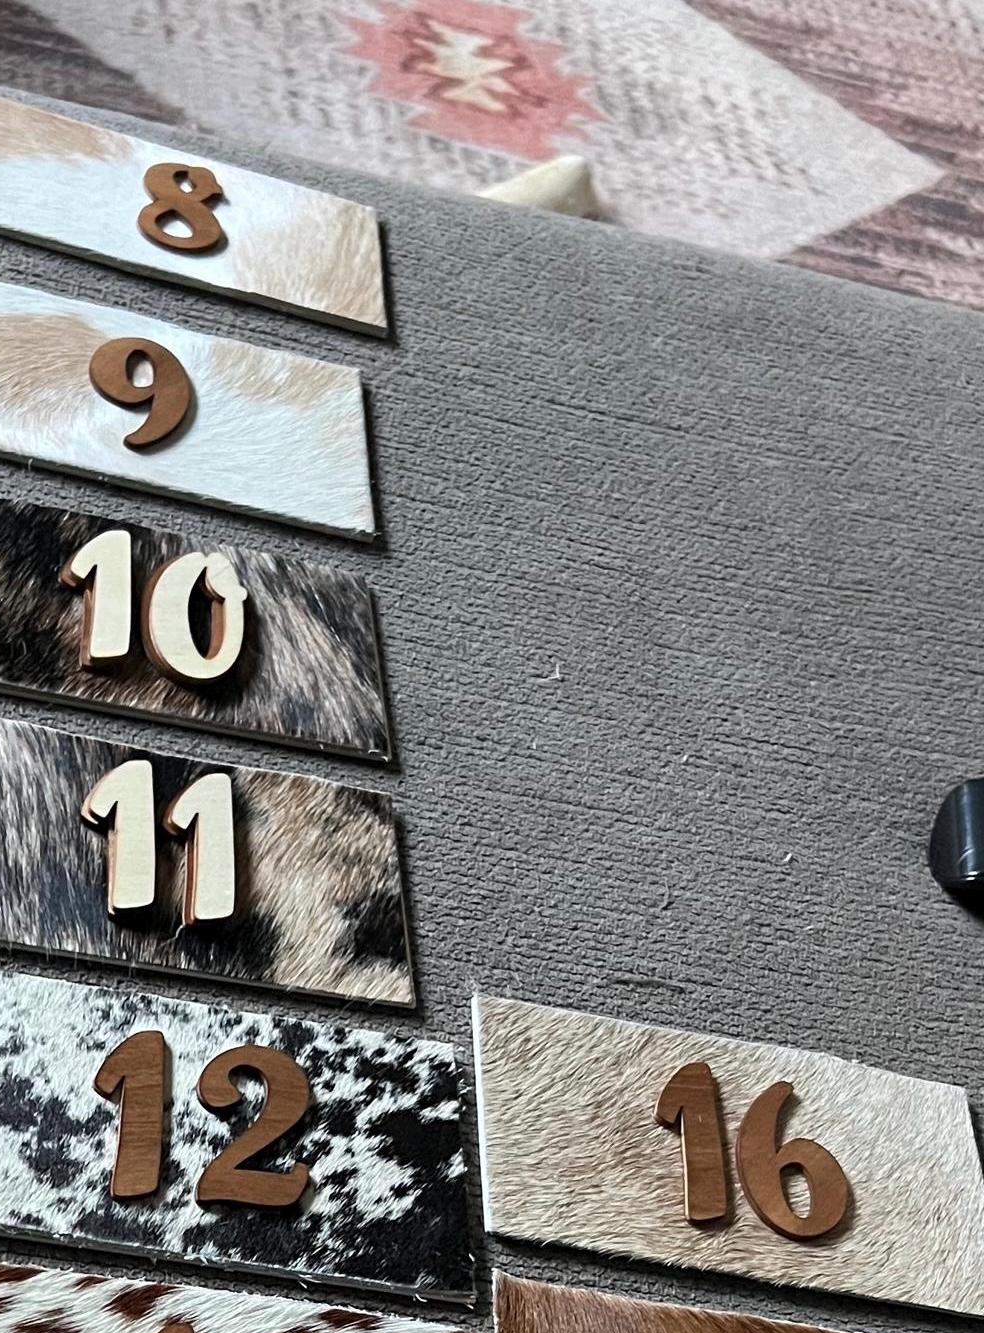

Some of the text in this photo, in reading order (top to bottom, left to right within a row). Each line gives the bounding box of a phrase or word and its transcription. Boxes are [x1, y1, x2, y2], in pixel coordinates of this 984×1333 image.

[138, 162, 226, 251] 8
[89, 337, 194, 450] 9
[60, 529, 249, 682] 10
[81, 759, 237, 923] 11
[94, 1030, 314, 1207] 12
[656, 1062, 851, 1241] 16
